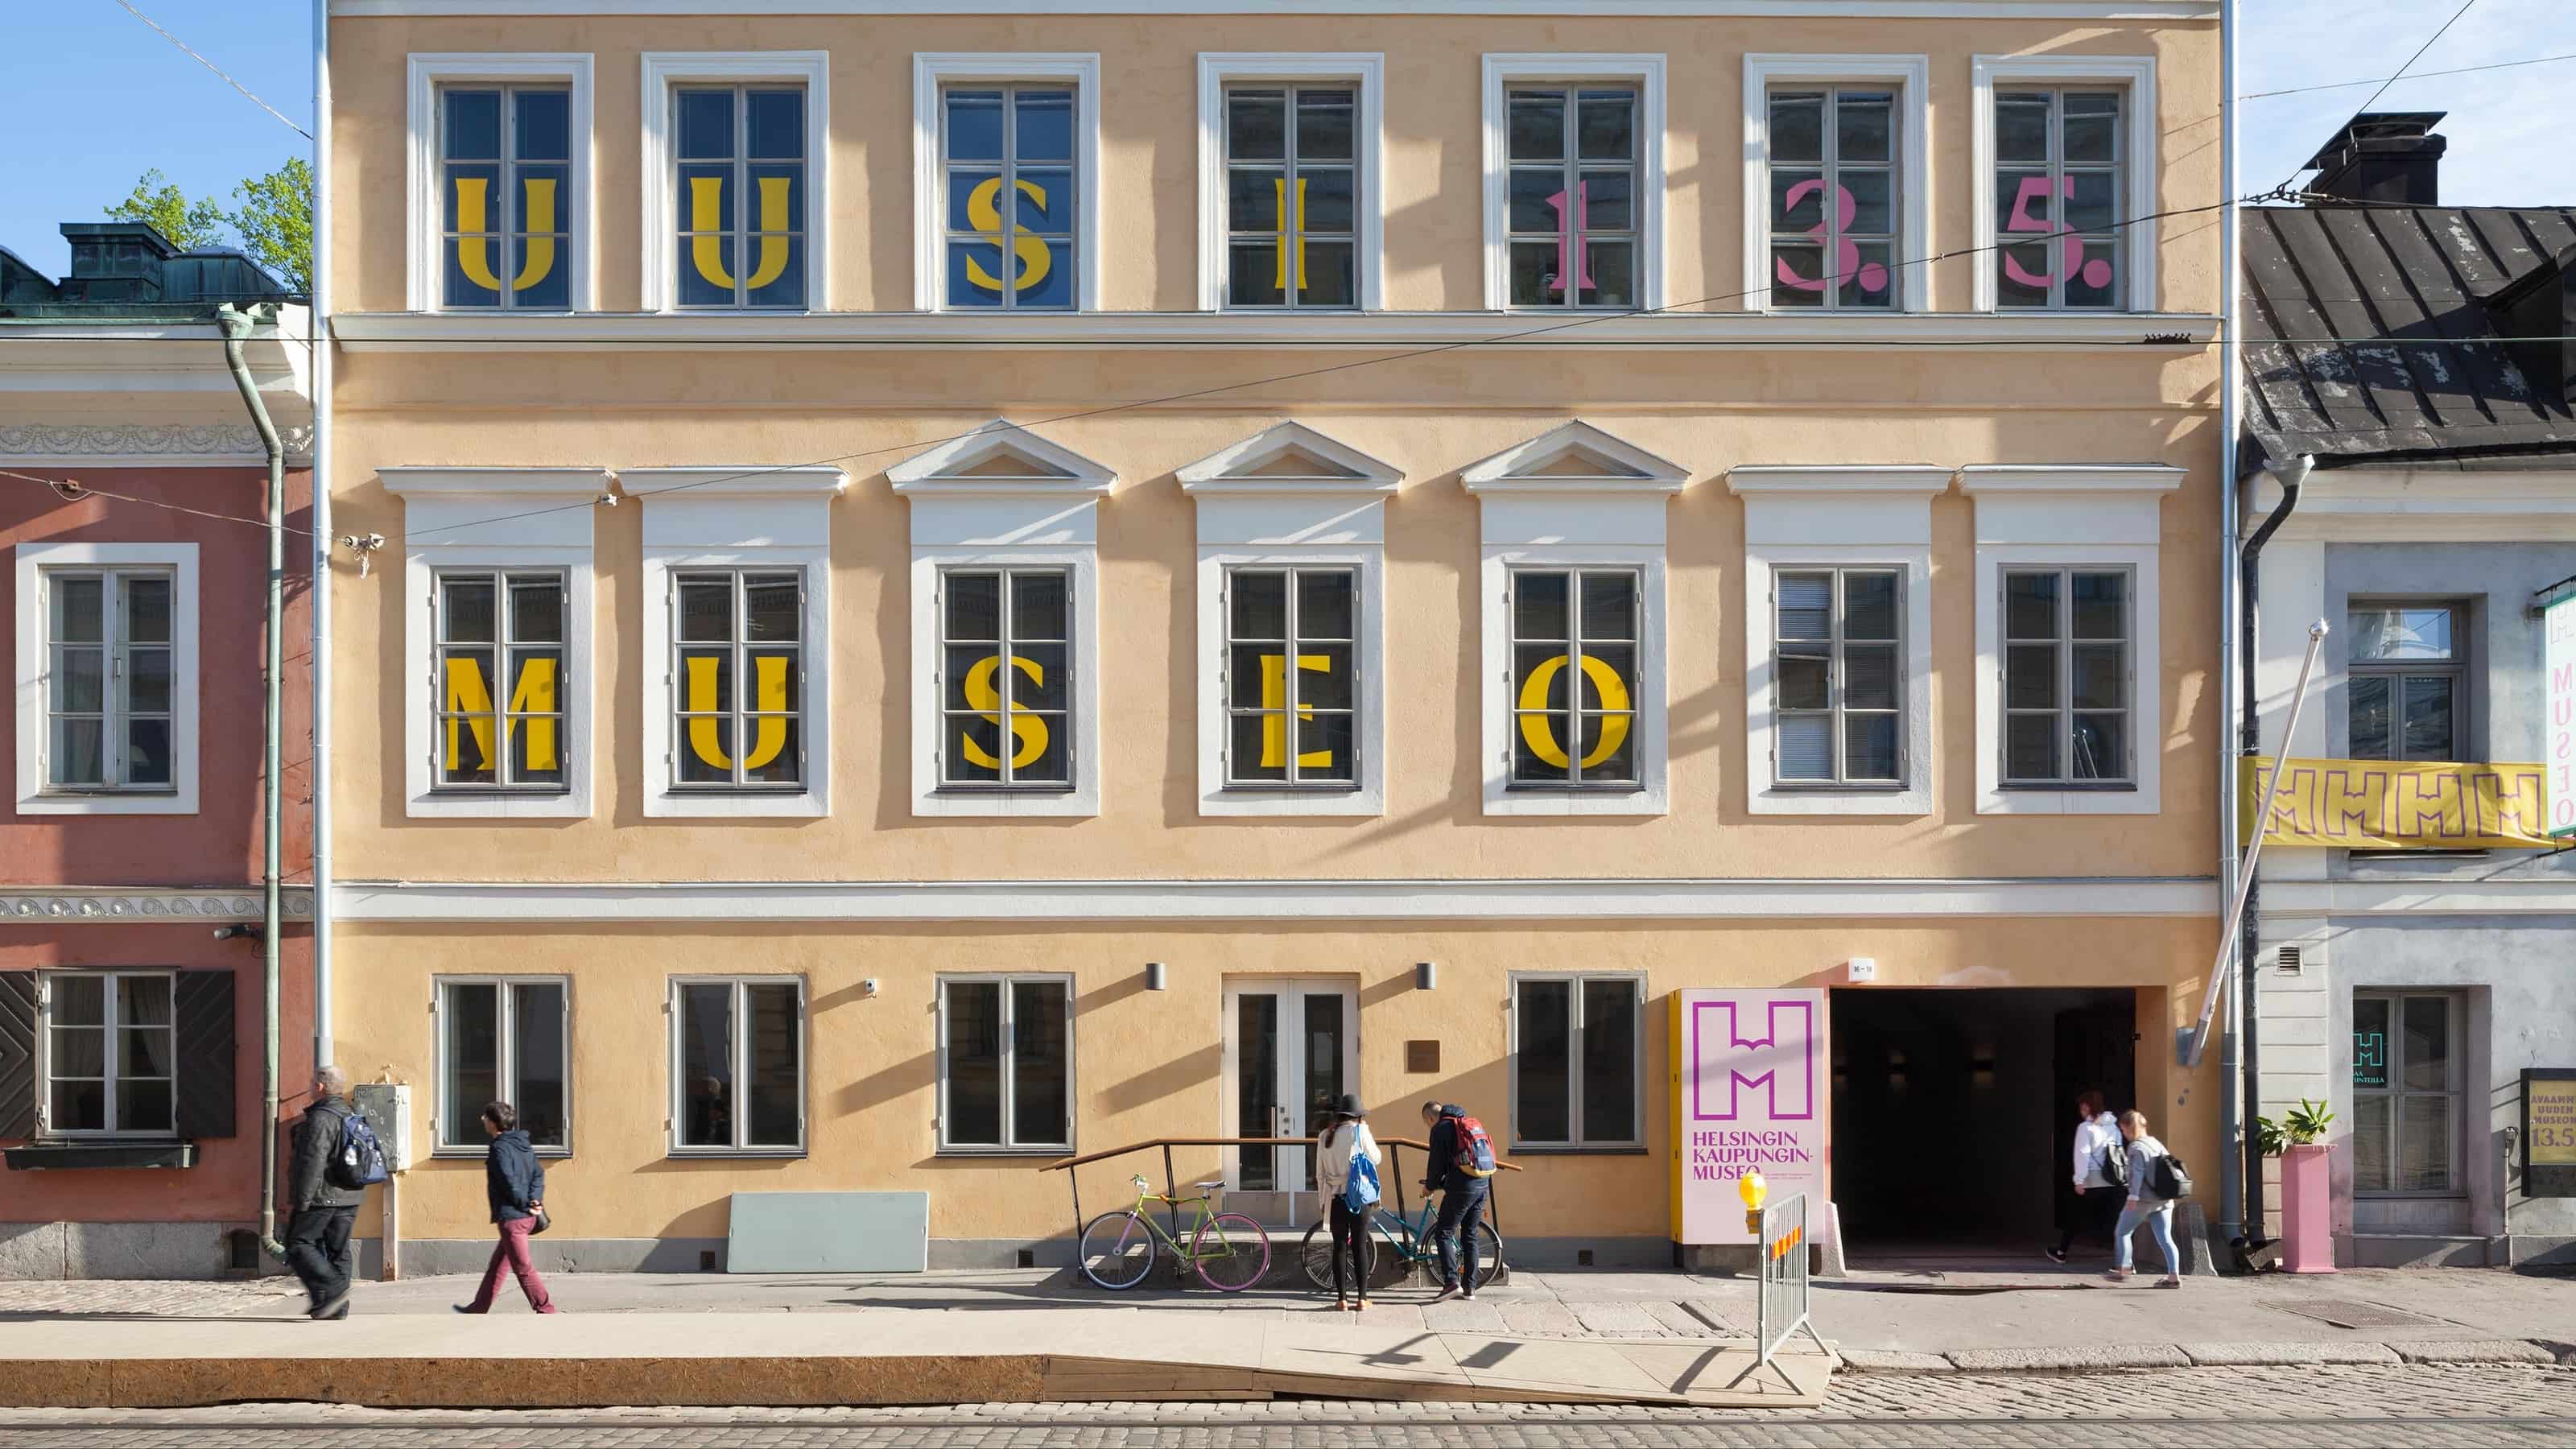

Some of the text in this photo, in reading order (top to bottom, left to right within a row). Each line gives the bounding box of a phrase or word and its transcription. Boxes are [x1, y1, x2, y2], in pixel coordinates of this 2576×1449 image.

[456, 177, 1308, 291] UUSI
[445, 654, 1632, 770] MUSEO
[2531, 1095, 2576, 1104] AVAAMM
[2537, 1105, 2574, 1114] UUDEN
[1693, 1131, 1798, 1146] HELSINGIN
[1693, 1148, 1814, 1163] KAUPUNGIN-
